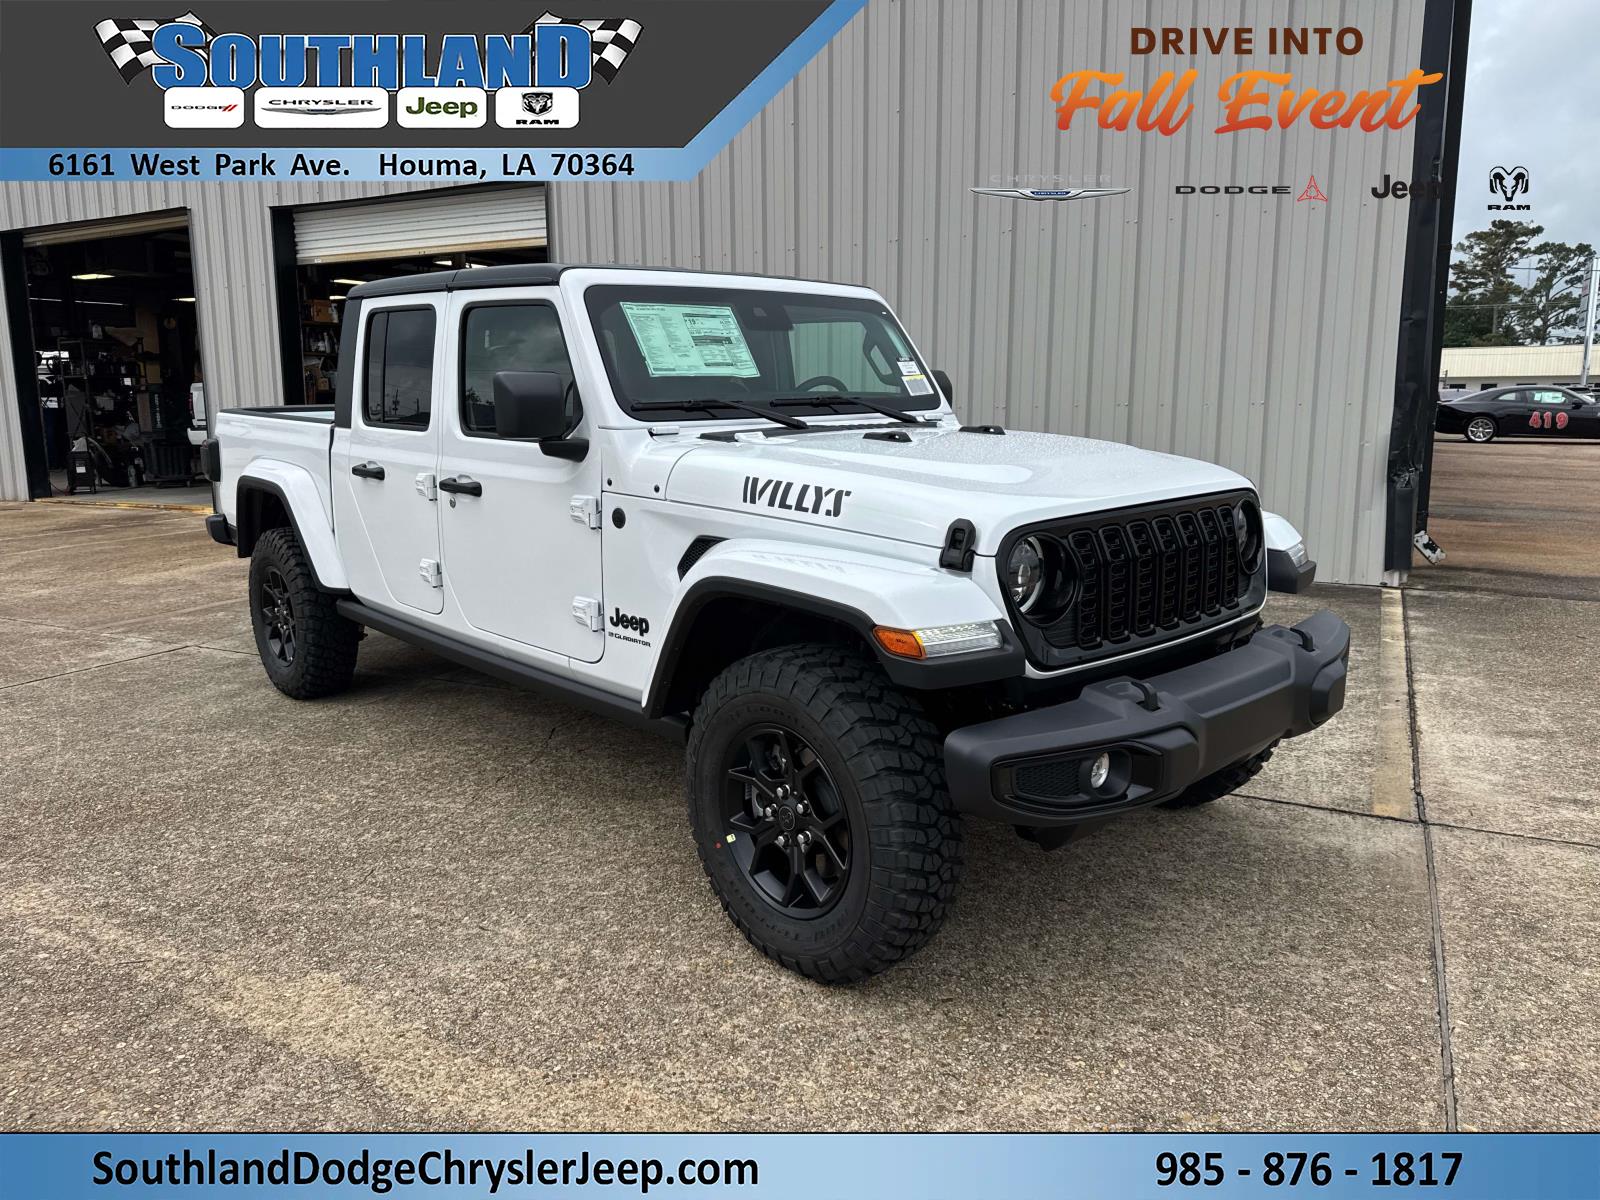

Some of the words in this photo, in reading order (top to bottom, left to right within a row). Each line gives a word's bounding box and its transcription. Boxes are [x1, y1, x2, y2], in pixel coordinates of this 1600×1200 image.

[1529, 411, 1569, 430] 419
[742, 476, 852, 518] WILLYS
[609, 607, 650, 637] Jeep
[614, 633, 652, 648] GLADIATOR
